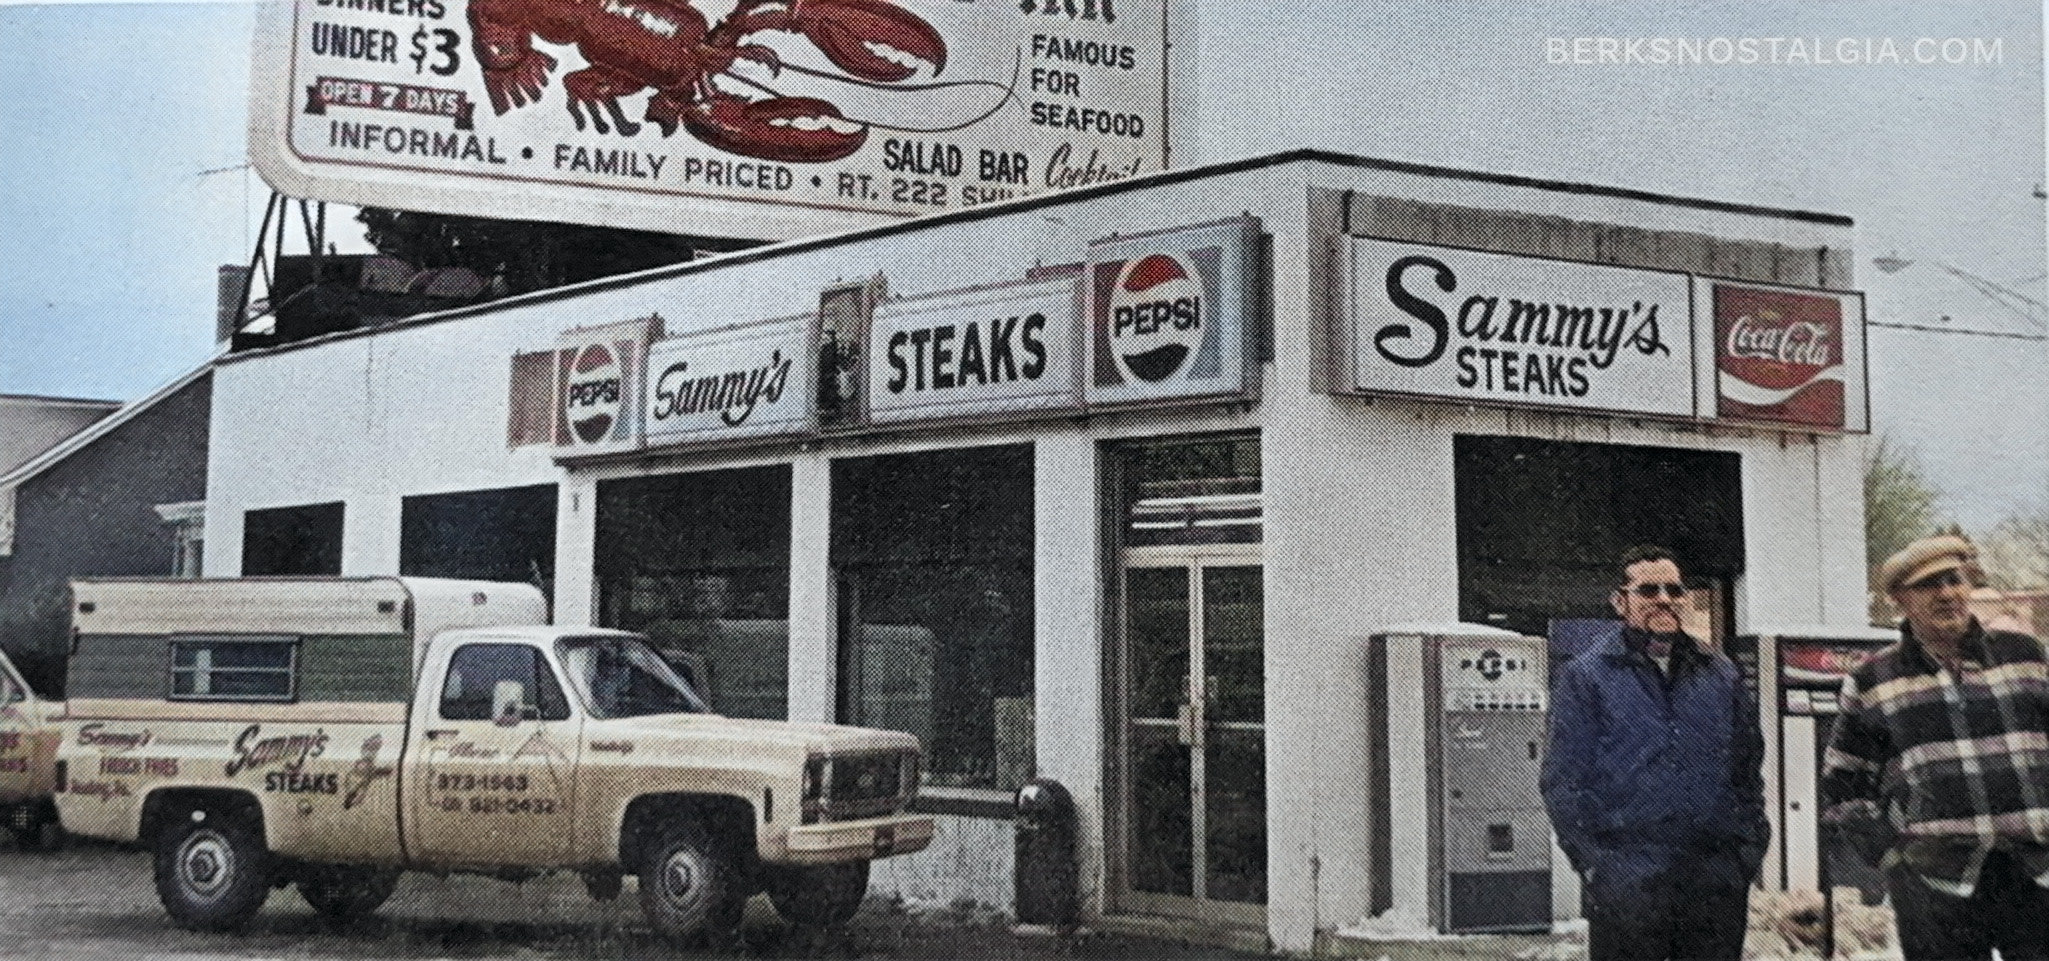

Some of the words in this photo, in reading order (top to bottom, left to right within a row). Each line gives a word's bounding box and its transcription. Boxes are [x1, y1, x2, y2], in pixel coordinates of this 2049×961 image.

[311, 21, 399, 63] UNDER
[409, 22, 461, 76] $3
[1031, 34, 1136, 70] FAMOUS
[320, 80, 374, 105] OPEN
[379, 85, 400, 108] 7
[405, 88, 459, 114] DAYS
[1031, 68, 1080, 97] FOR
[1031, 102, 1145, 138] SEAFOOD
[329, 120, 507, 164] INFORMAL
[553, 143, 668, 180] FAMILY
[684, 156, 794, 192] PRICED
[837, 172, 879, 200] RT.
[891, 177, 947, 206] 222
[883, 138, 963, 178] SALAD
[978, 148, 1030, 186] BAR
[1113, 296, 1202, 338] PEPSI
[1373, 254, 1671, 369] Sammy's
[886, 312, 1047, 395] STEAKS
[1455, 346, 1591, 398] STEAKS
[568, 377, 621, 408] PEPSI
[653, 349, 794, 427] Sammy's
[224, 723, 331, 778] Sammy's
[264, 771, 339, 795] STEAKS
